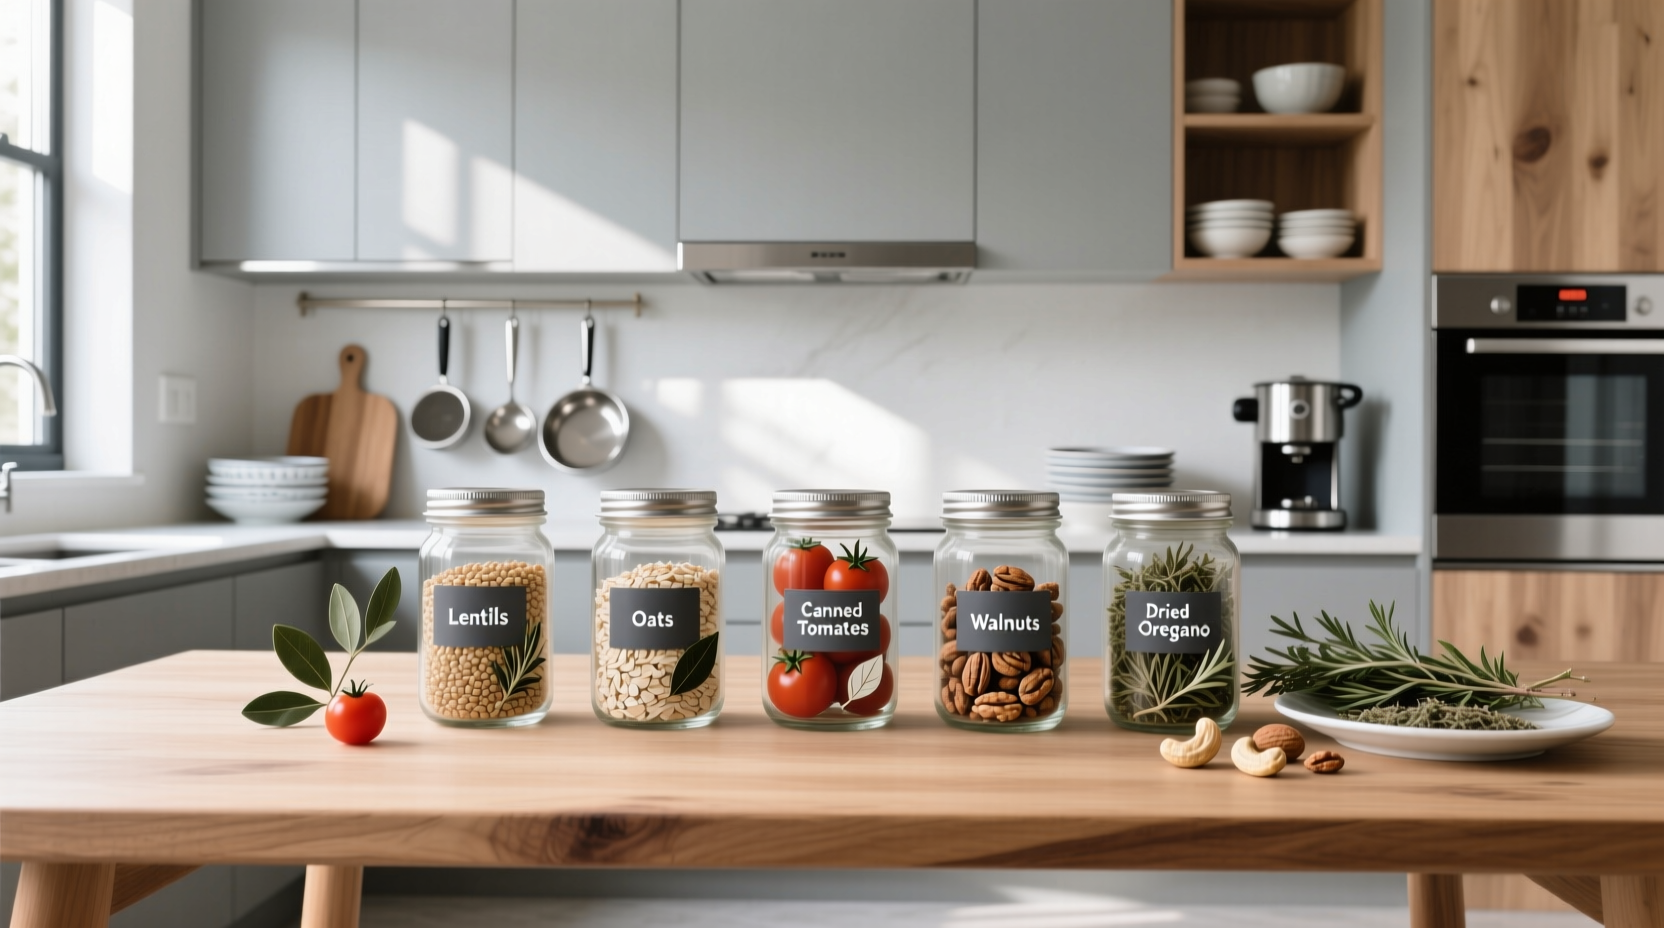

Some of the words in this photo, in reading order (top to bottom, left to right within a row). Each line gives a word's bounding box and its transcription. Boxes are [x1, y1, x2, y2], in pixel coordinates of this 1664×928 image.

[448, 606, 509, 626] Lentils
[631, 609, 674, 628] Oats
[800, 601, 863, 618] Canned
[1146, 602, 1190, 620] Dried
[796, 619, 870, 636] Tomates
[970, 612, 1040, 631] Walnuts
[1137, 619, 1211, 642] Oregano
